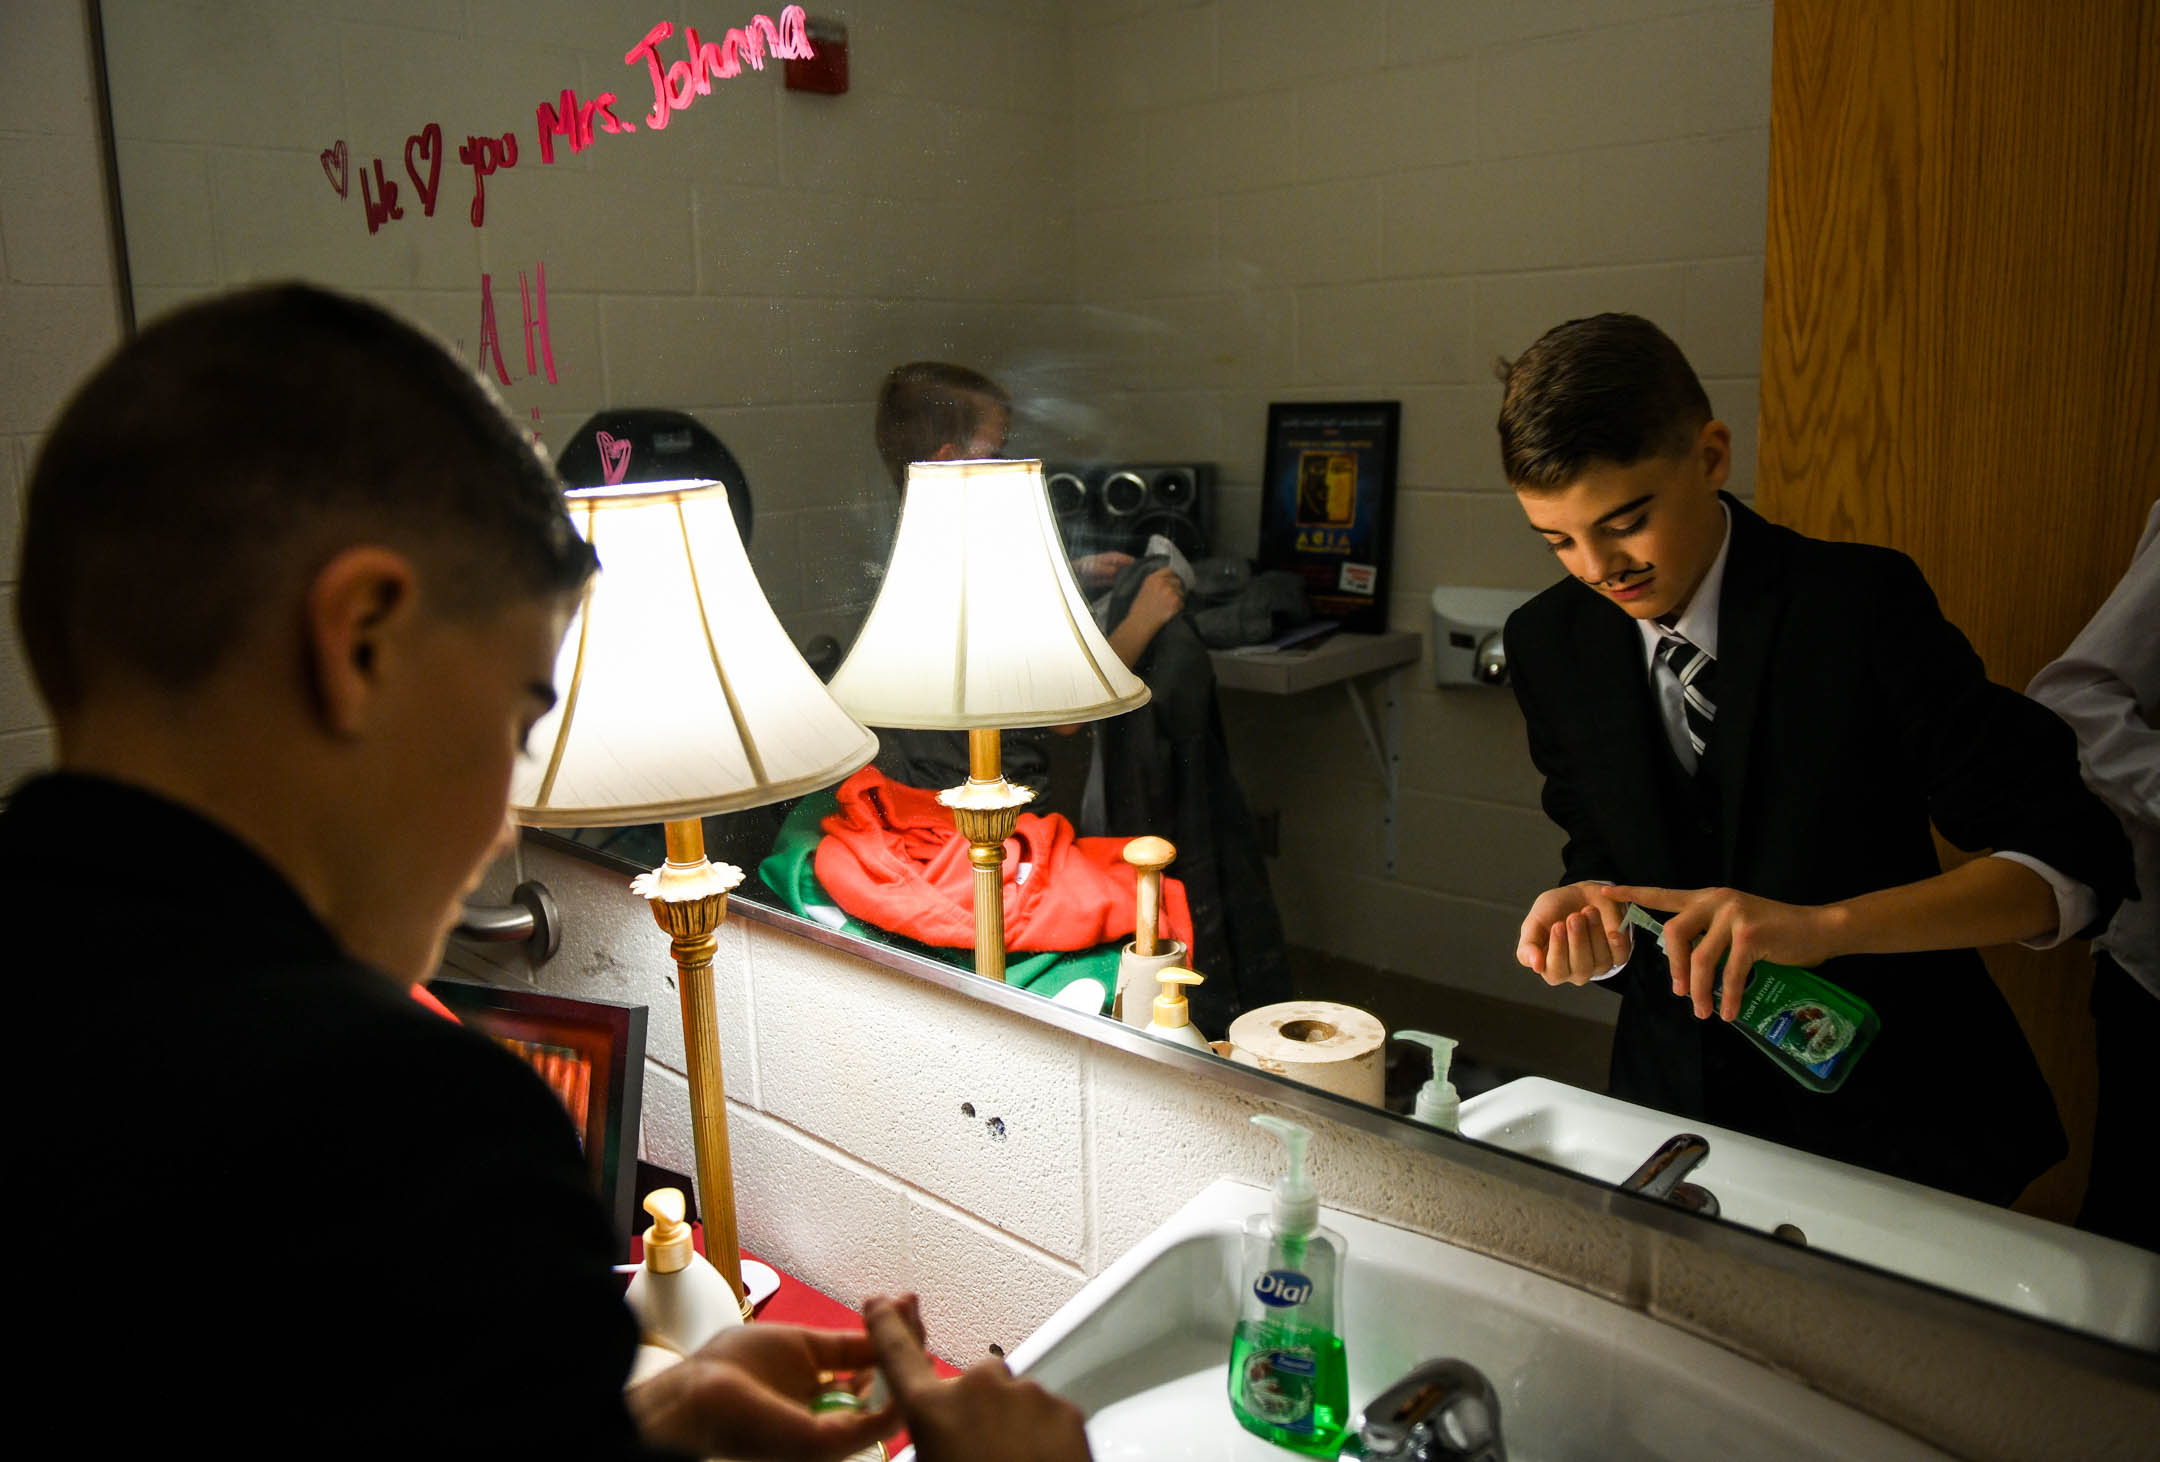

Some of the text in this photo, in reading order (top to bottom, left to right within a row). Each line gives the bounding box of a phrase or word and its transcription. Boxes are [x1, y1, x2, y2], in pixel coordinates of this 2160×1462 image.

[459, 132, 519, 228] you
[536, 88, 637, 164] Mrs.
[1255, 1271, 1310, 1304] Dial
